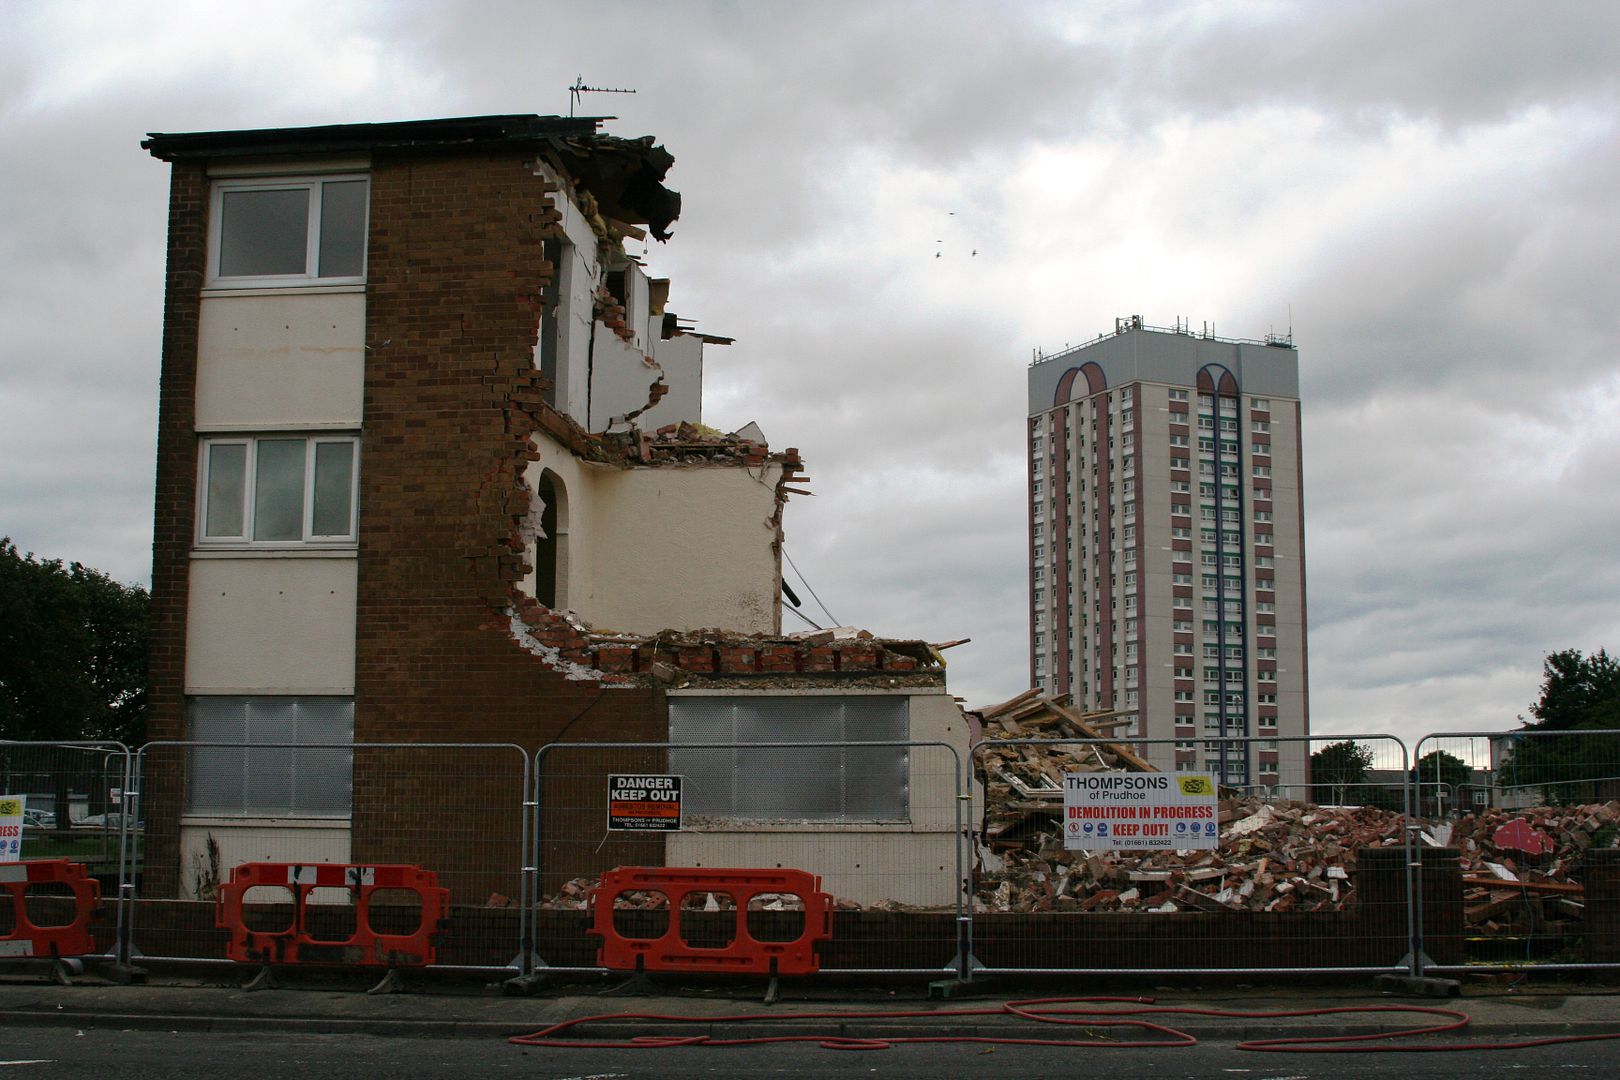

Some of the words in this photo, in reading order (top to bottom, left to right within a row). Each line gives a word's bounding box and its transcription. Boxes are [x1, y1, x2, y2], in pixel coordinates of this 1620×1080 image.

[617, 777, 673, 789] DANGER
[1066, 777, 1168, 789] THOMPSONS
[611, 789, 647, 801] KEEP
[650, 790, 679, 801] OUT
[1089, 791, 1100, 800] of
[1102, 791, 1146, 800] Prudhoe
[1069, 806, 1136, 819] DEMOLITION
[1139, 806, 1151, 819] IN
[1153, 806, 1213, 819] PROGRESS
[1113, 823, 1140, 836] KEEP
[1142, 823, 1169, 836] OUT!
